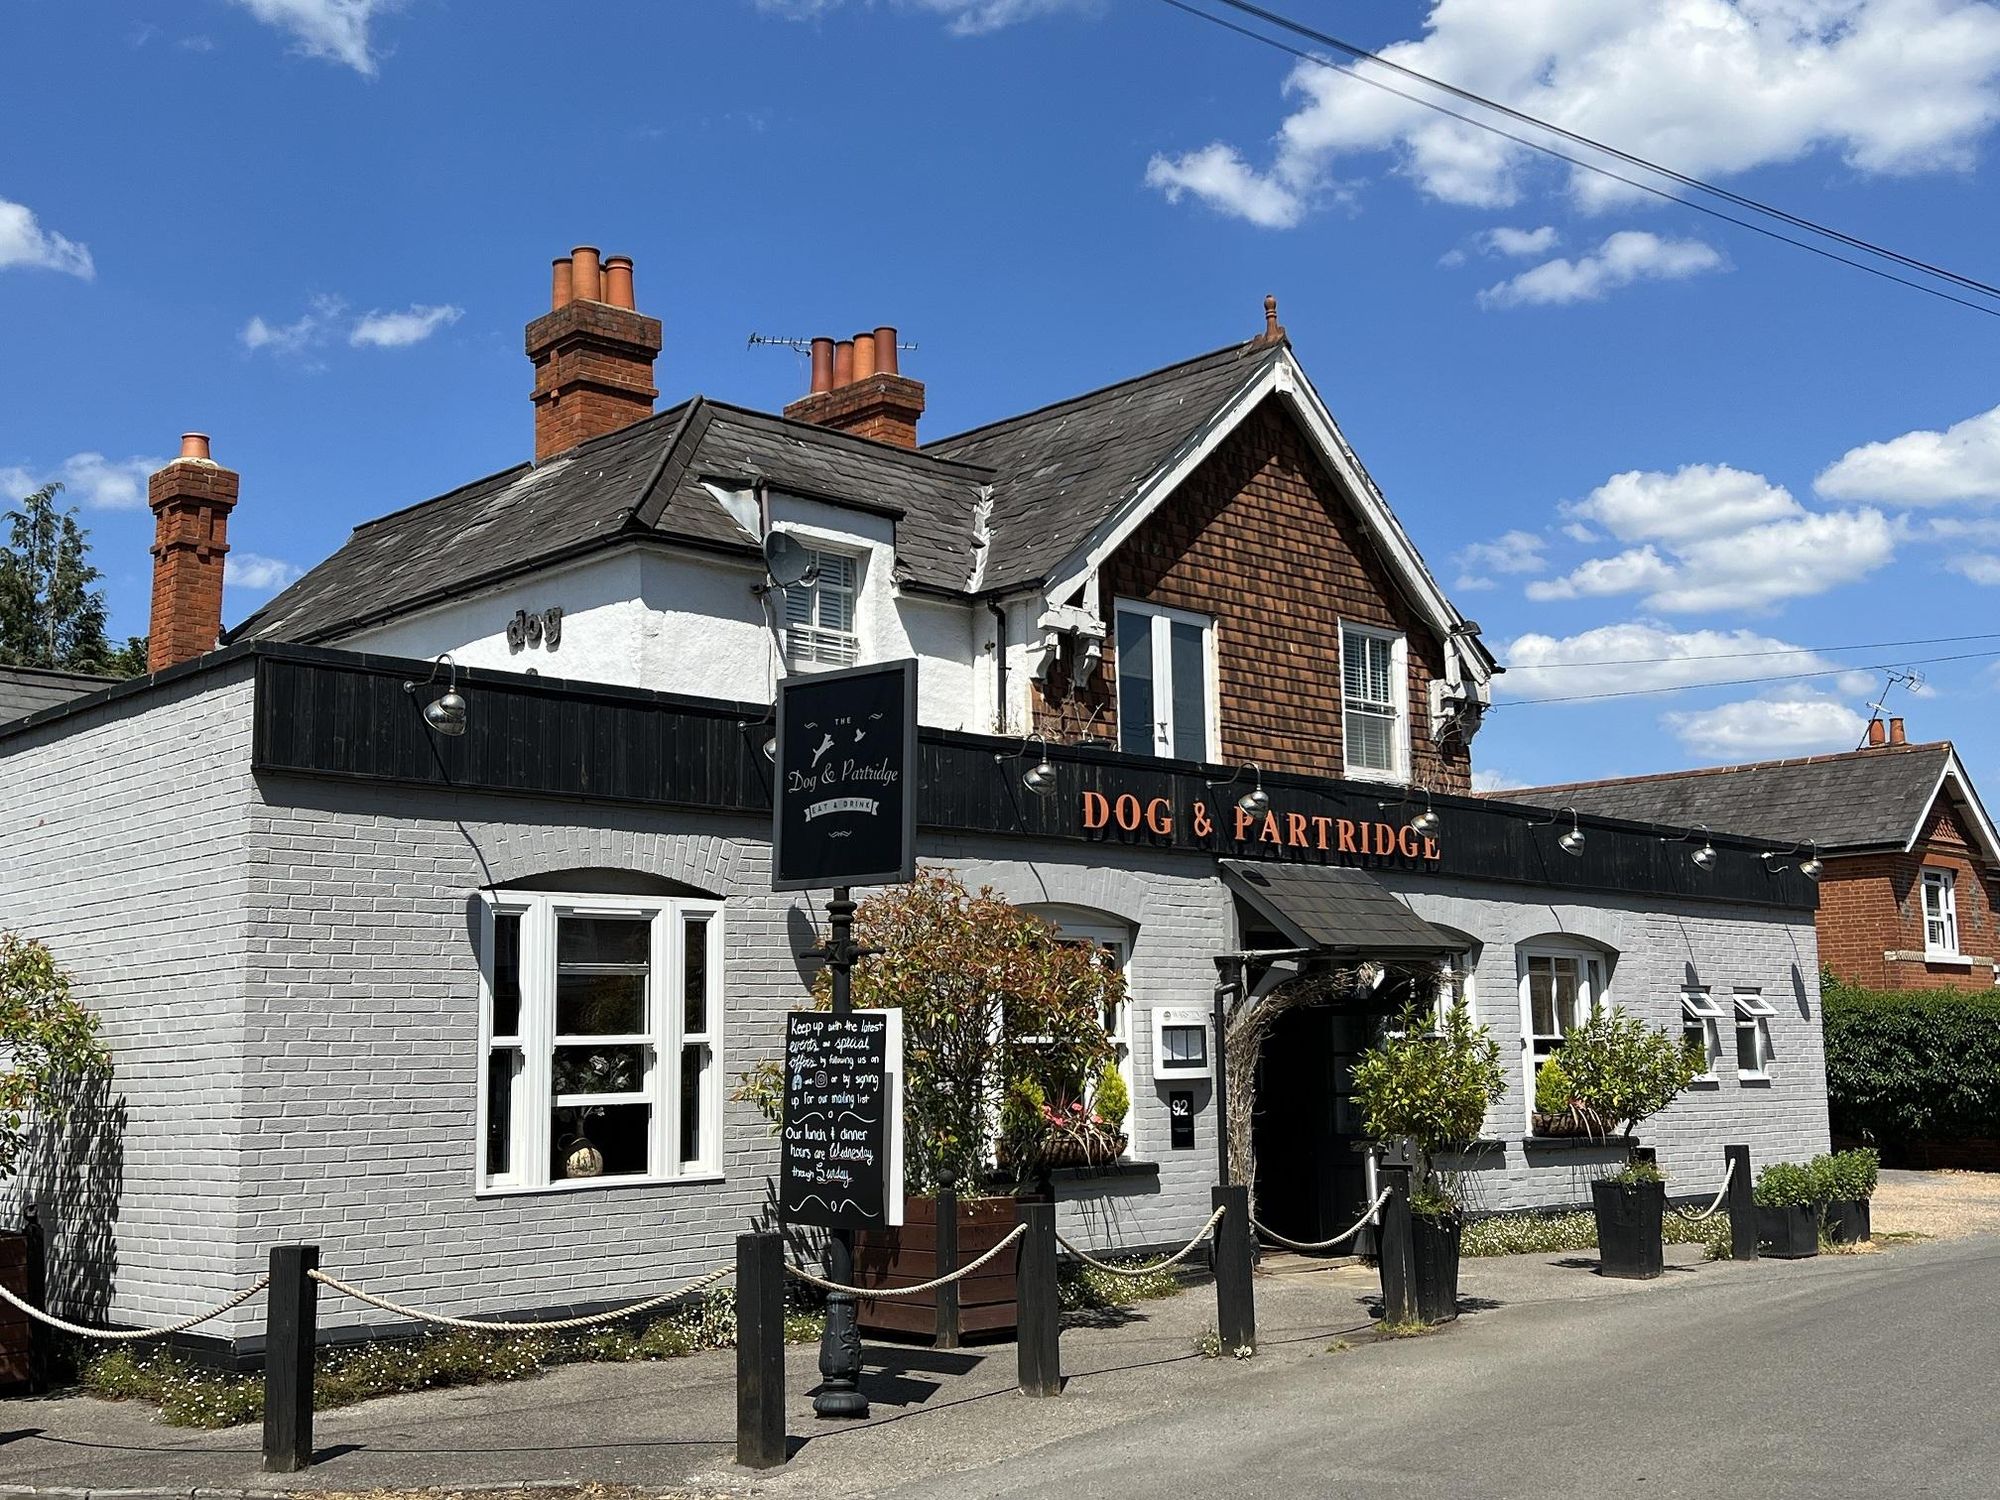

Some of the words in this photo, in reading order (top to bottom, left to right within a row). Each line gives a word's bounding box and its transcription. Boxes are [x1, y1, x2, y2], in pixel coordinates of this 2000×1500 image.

[507, 606, 563, 646] dog
[836, 717, 851, 725] THE
[788, 769, 817, 793] Dog
[821, 762, 836, 784] &
[841, 757, 899, 787] Partridge
[812, 803, 829, 815] EAT
[843, 799, 870, 810] DRINK
[1081, 790, 1173, 835] DOG
[1193, 802, 1214, 837] &
[1233, 805, 1441, 860] PARTRIDGE
[791, 1017, 812, 1036] Keep
[812, 1021, 824, 1036] up
[828, 1020, 842, 1032] with
[844, 1019, 858, 1032] the
[861, 1018, 884, 1033] latest
[789, 1037, 819, 1053] events
[834, 1036, 870, 1054] special
[788, 1054, 817, 1073] offers
[820, 1056, 827, 1068] by
[829, 1054, 854, 1070] following
[857, 1056, 867, 1064] us
[870, 1056, 880, 1064] on
[831, 1076, 838, 1084] or
[842, 1073, 851, 1088] by
[855, 1073, 879, 1092] signing
[791, 1096, 800, 1109] up
[803, 1091, 814, 1105] for
[818, 1094, 828, 1104] our
[831, 1091, 854, 1109] mailing
[857, 1094, 870, 1104] list
[1173, 1100, 1188, 1116] 92
[785, 1126, 802, 1140] Our
[804, 1123, 827, 1141] lunch
[840, 1127, 868, 1141] dinner
[790, 1143, 812, 1160] hours
[814, 1149, 826, 1160] are
[829, 1142, 873, 1166] Wednesday
[791, 1165, 815, 1182] through
[815, 1162, 853, 1188] Sunday
